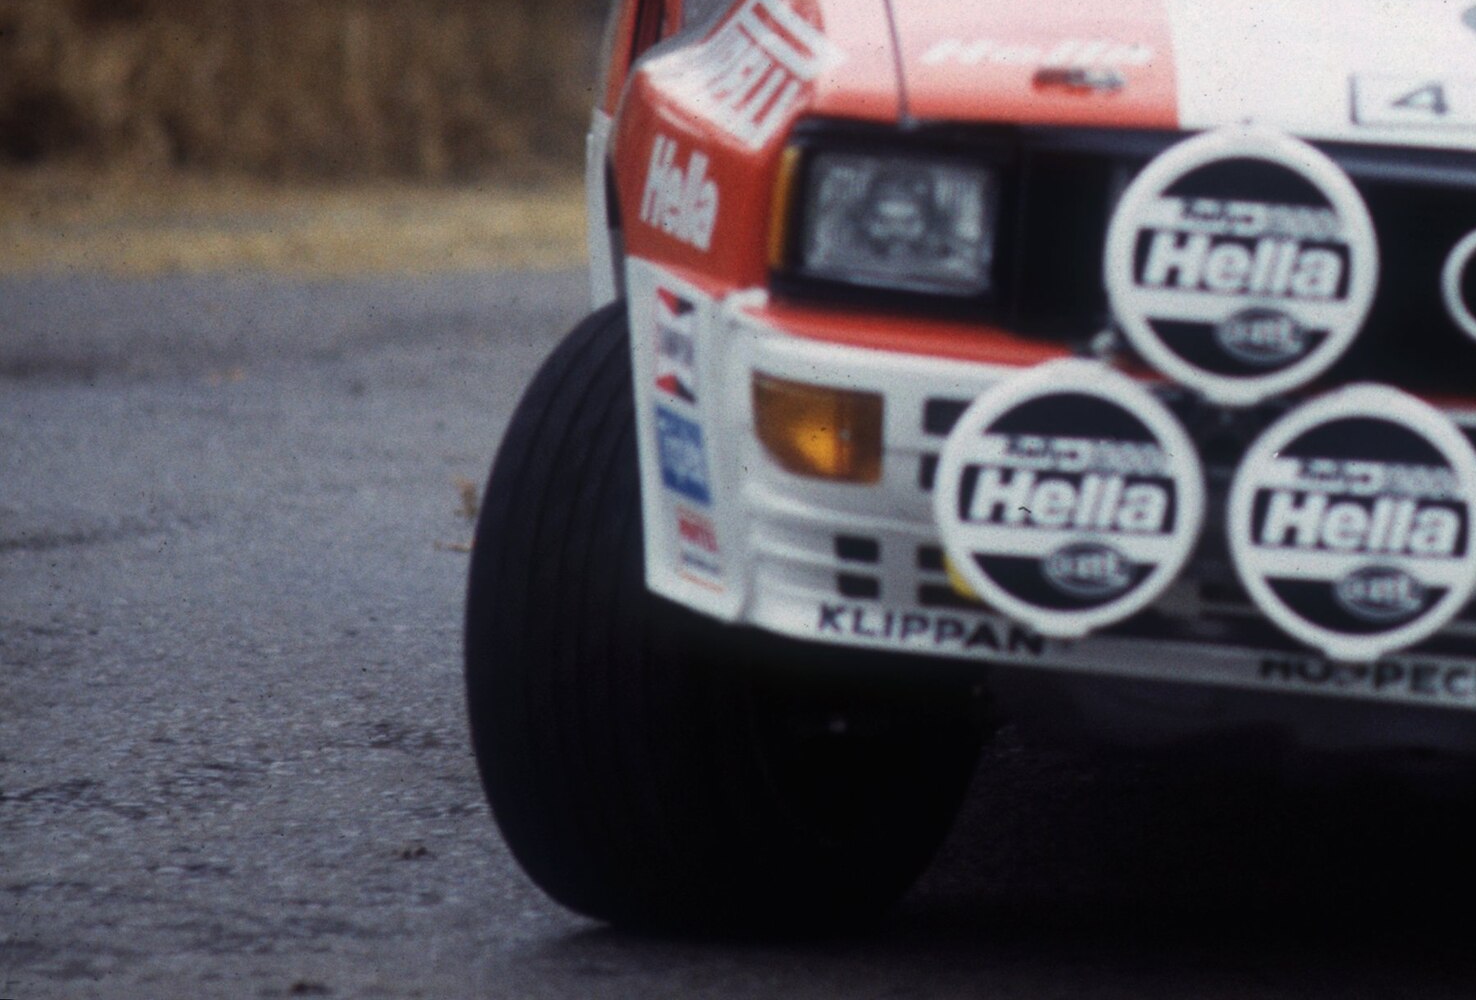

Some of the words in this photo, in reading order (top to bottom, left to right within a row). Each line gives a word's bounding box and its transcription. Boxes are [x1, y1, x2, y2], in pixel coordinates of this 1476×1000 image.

[640, 133, 719, 250] Hella
[1142, 229, 1344, 299] Hella
[968, 465, 1168, 533] Hella
[1259, 489, 1460, 553] Hella
[818, 603, 1045, 657] KLIPPAN
